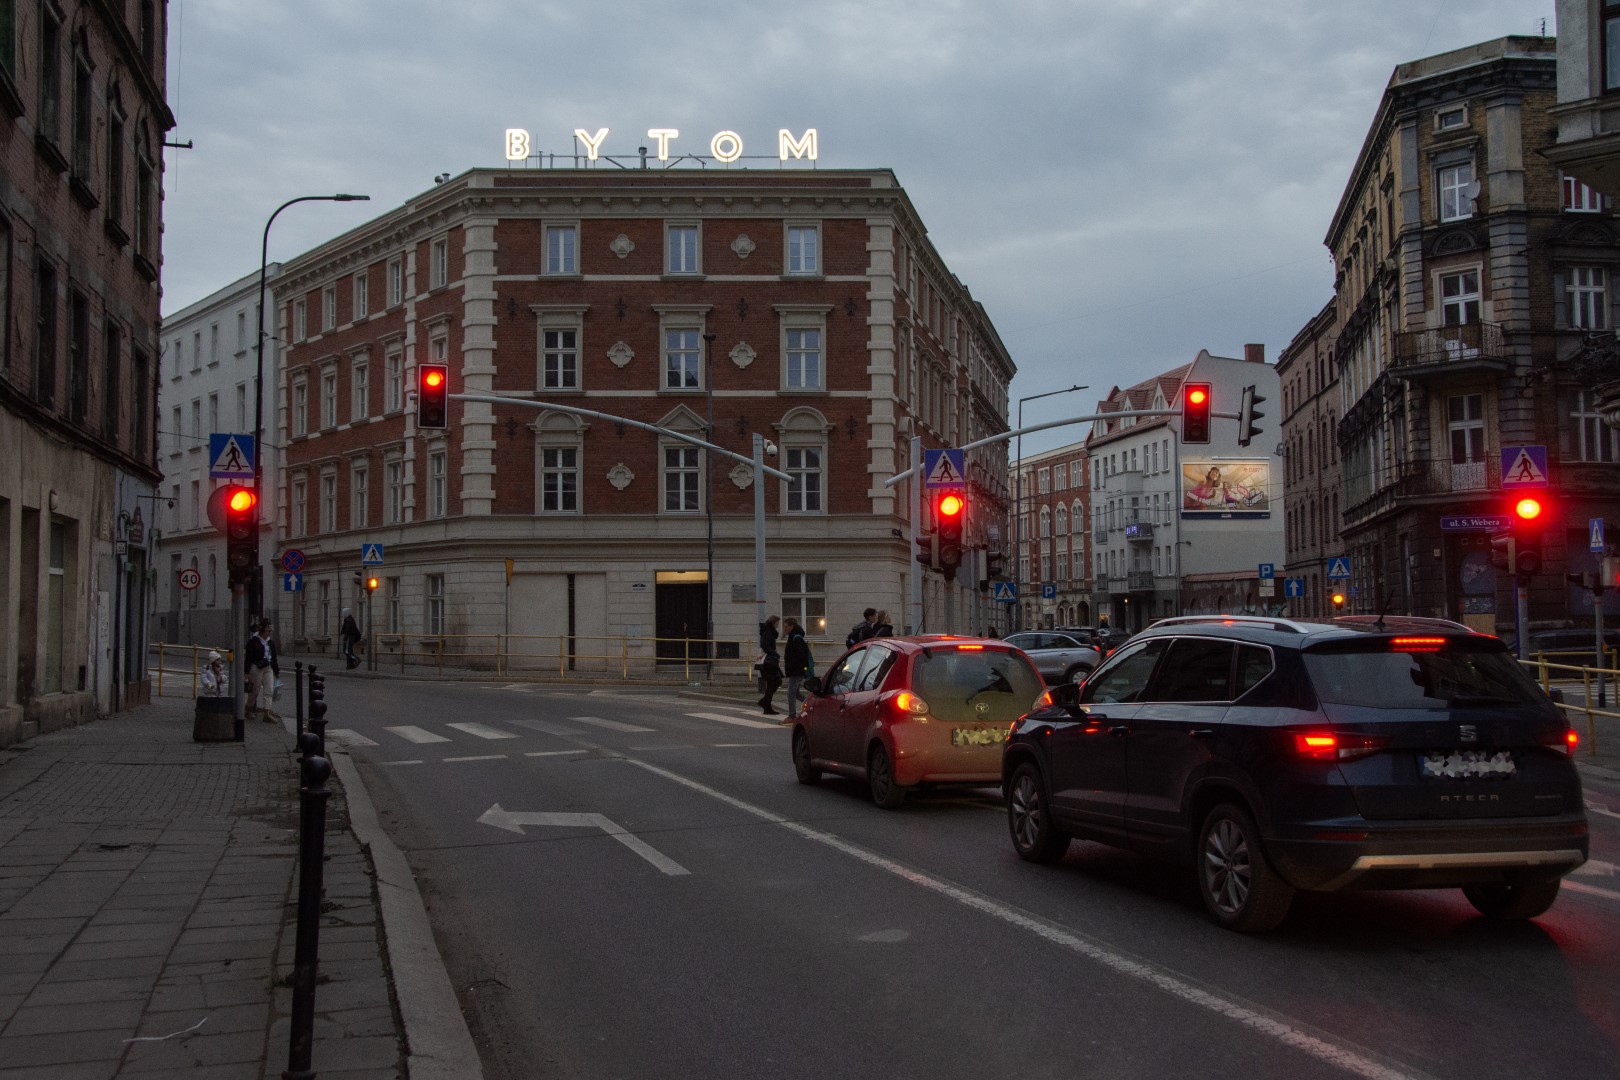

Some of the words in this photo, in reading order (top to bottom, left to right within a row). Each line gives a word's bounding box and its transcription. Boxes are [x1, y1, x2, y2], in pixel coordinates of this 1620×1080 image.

[505, 128, 818, 162] BYTOM
[1449, 519, 1460, 527] ul.
[1461, 519, 1470, 527] S.
[1471, 518, 1500, 526] Webera
[1261, 565, 1271, 577] P
[182, 574, 198, 584] 40
[1044, 586, 1054, 597] P
